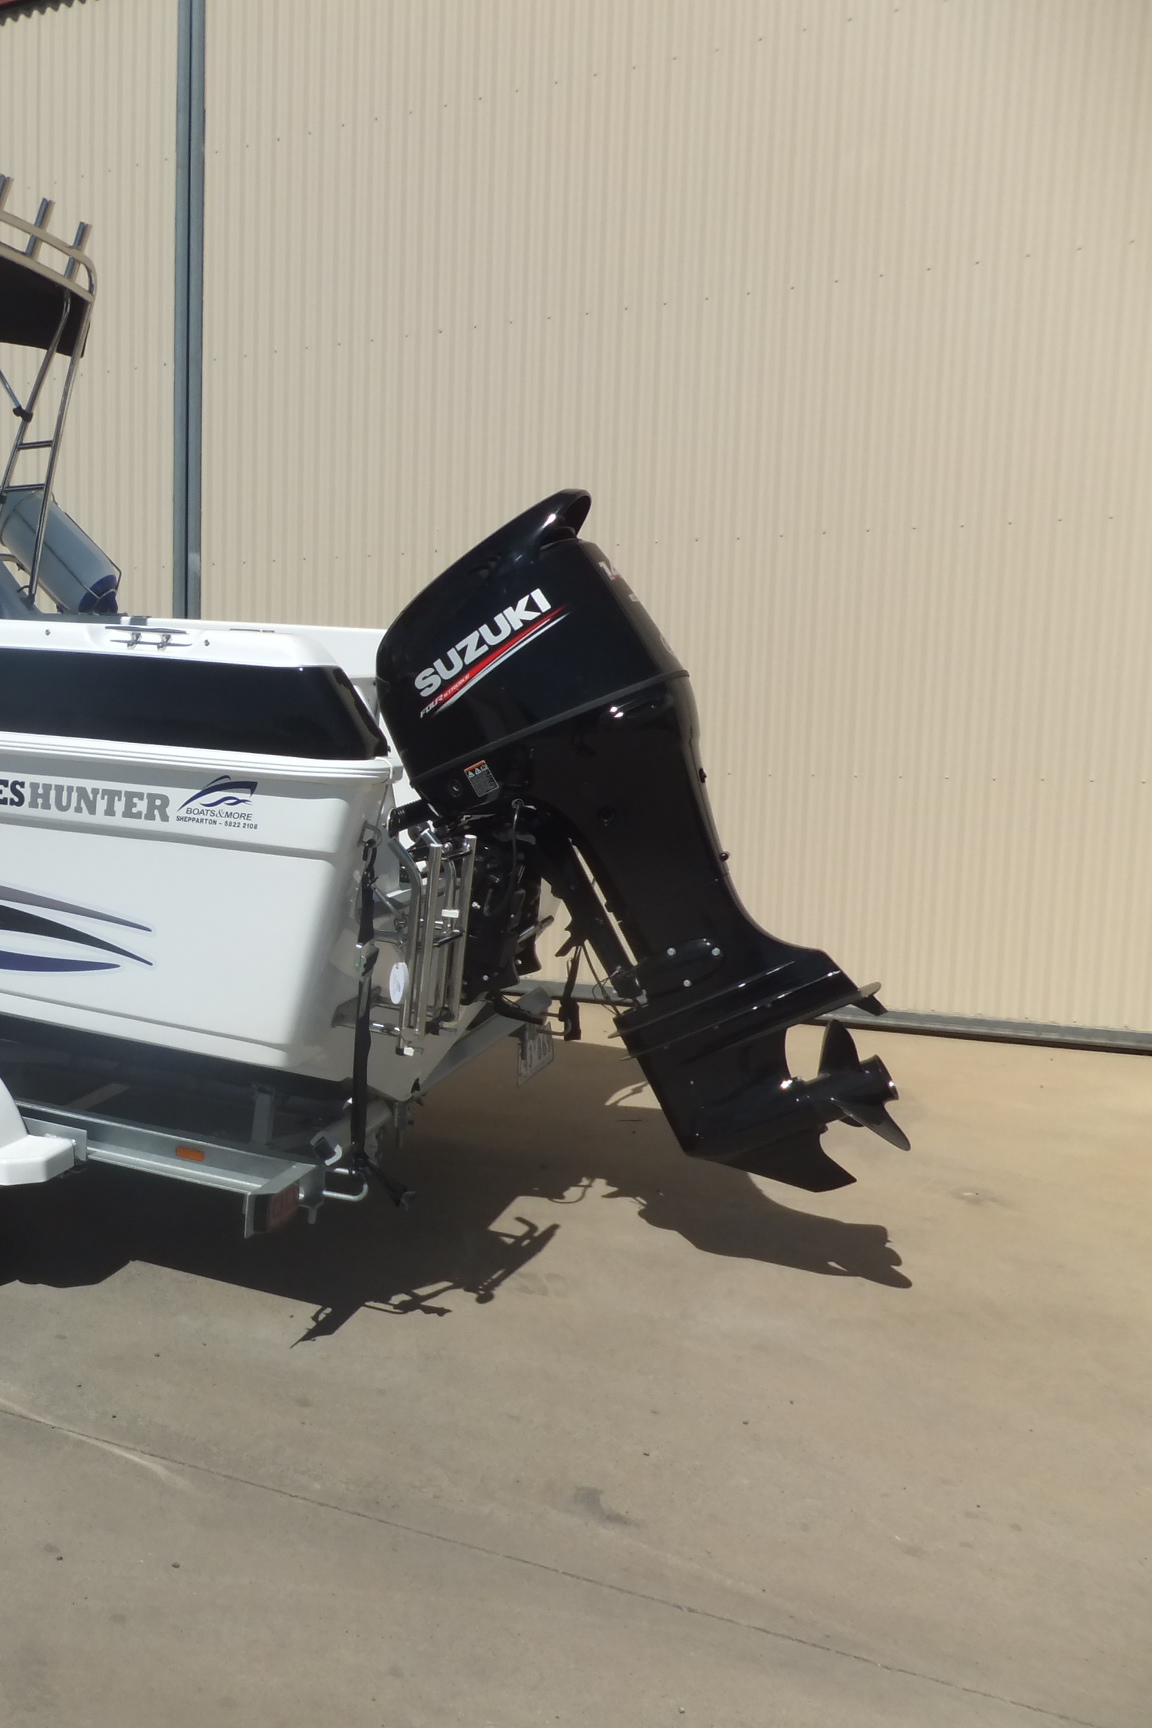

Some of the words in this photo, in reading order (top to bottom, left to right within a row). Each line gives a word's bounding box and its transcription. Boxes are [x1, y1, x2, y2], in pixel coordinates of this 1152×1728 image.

[414, 588, 552, 697] SUZUKI
[28, 781, 170, 823] HUNTER
[176, 815, 218, 826] SHEPPARTON
